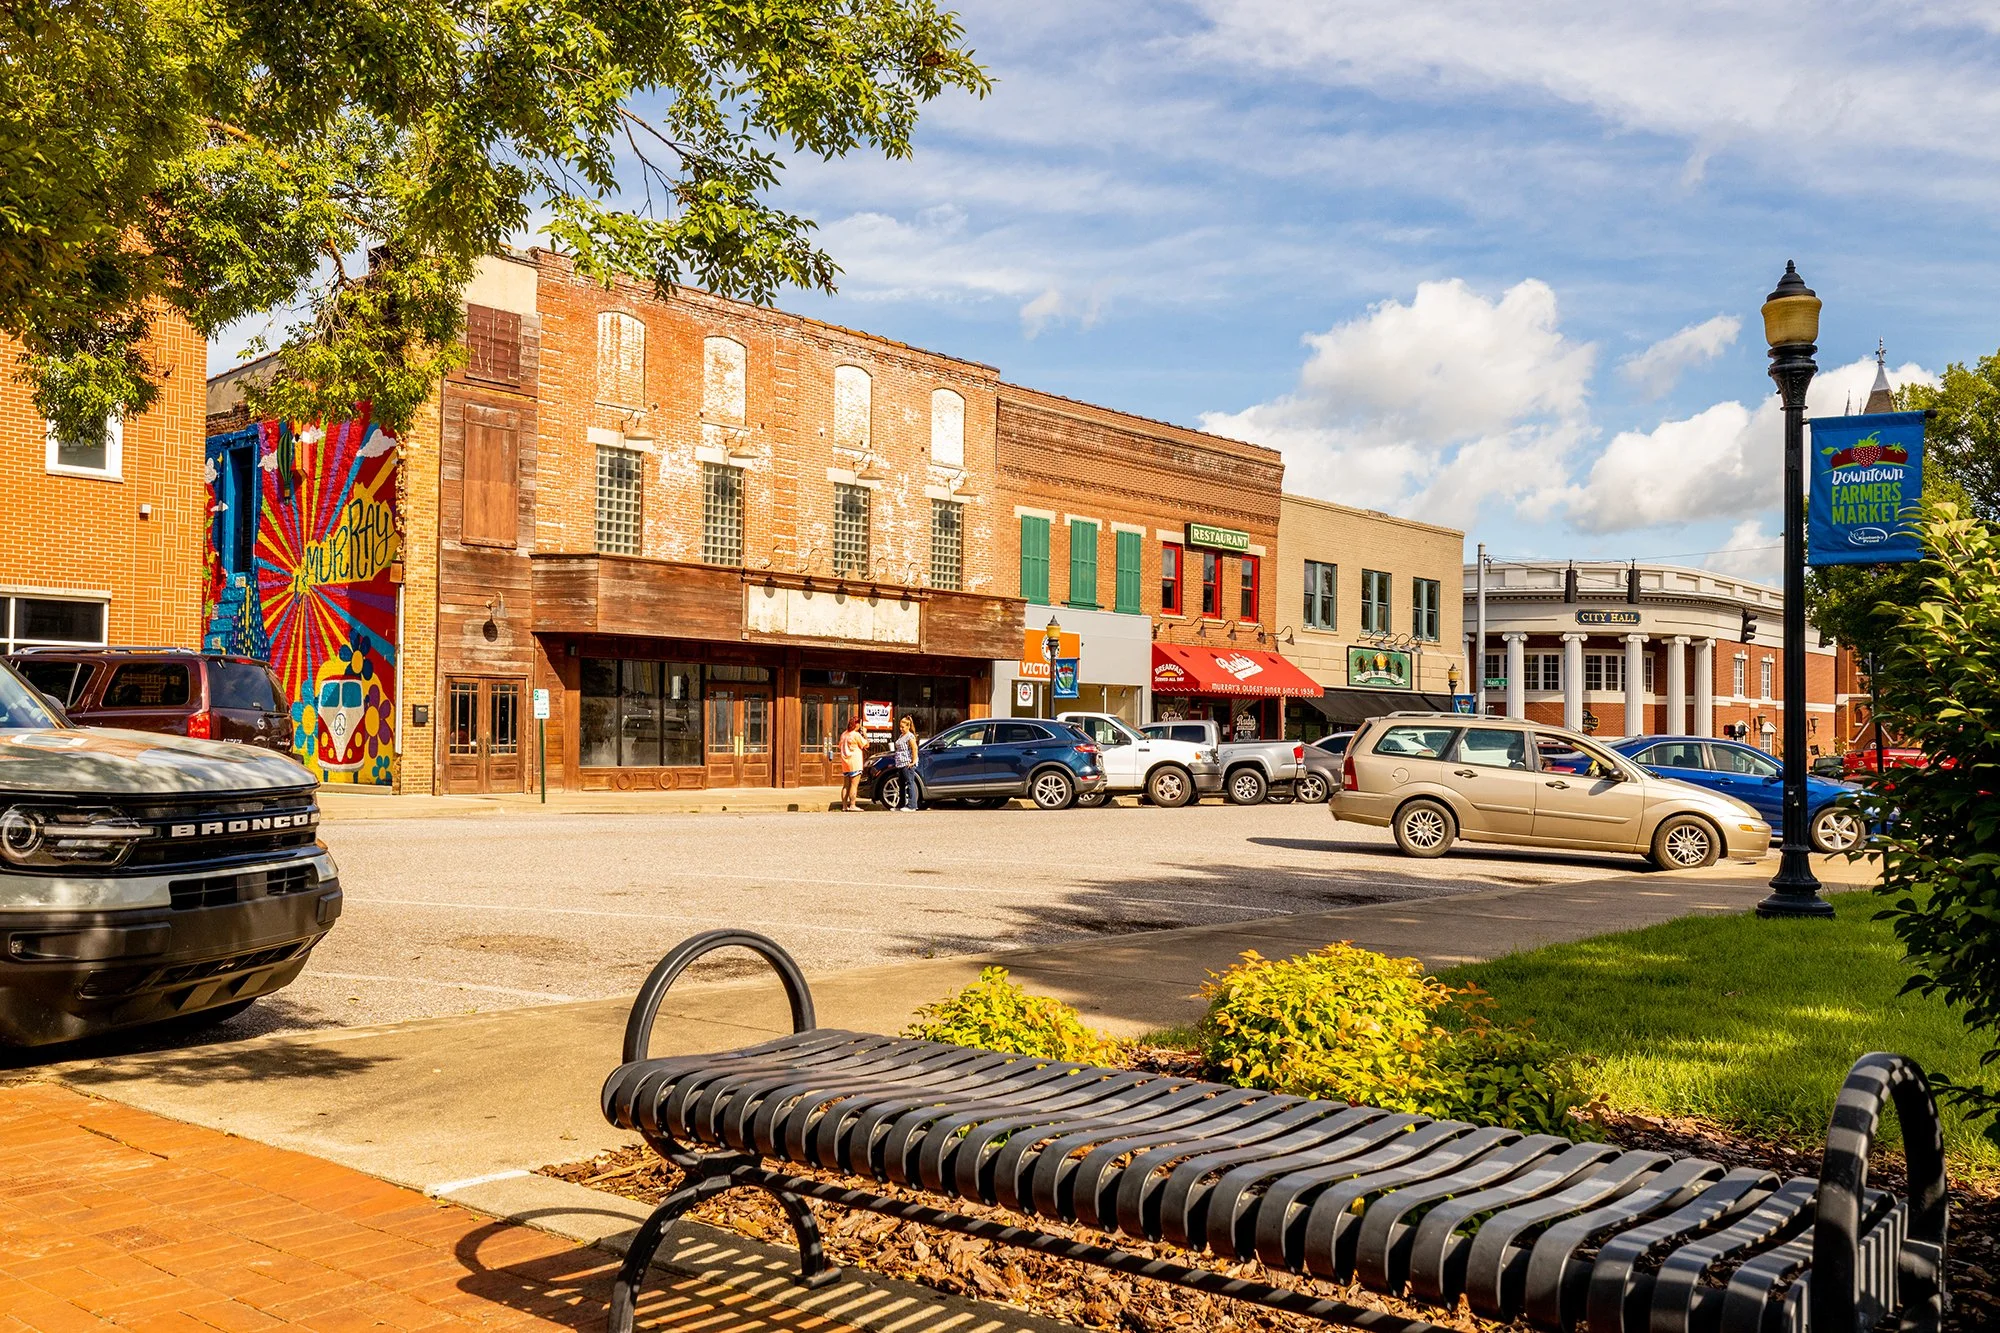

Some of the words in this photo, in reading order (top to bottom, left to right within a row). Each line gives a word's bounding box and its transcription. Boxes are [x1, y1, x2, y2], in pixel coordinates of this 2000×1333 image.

[1831, 482, 1902, 505] FARMERS
[1831, 502, 1902, 525] MARKET
[306, 498, 396, 583] MURRAY
[1193, 528, 1248, 547] RESTAURANT
[1581, 613, 1607, 622] CITY
[1610, 613, 1637, 622] HALL
[1021, 662, 1052, 676] VICTO
[1154, 663, 1185, 676] BREAKFAST
[1211, 683, 1241, 692] MURRAY'S
[1242, 685, 1263, 693] OLDEST
[1264, 686, 1282, 694] DINER
[1282, 687, 1299, 695] SINCE
[171, 814, 308, 838] BRONCO
